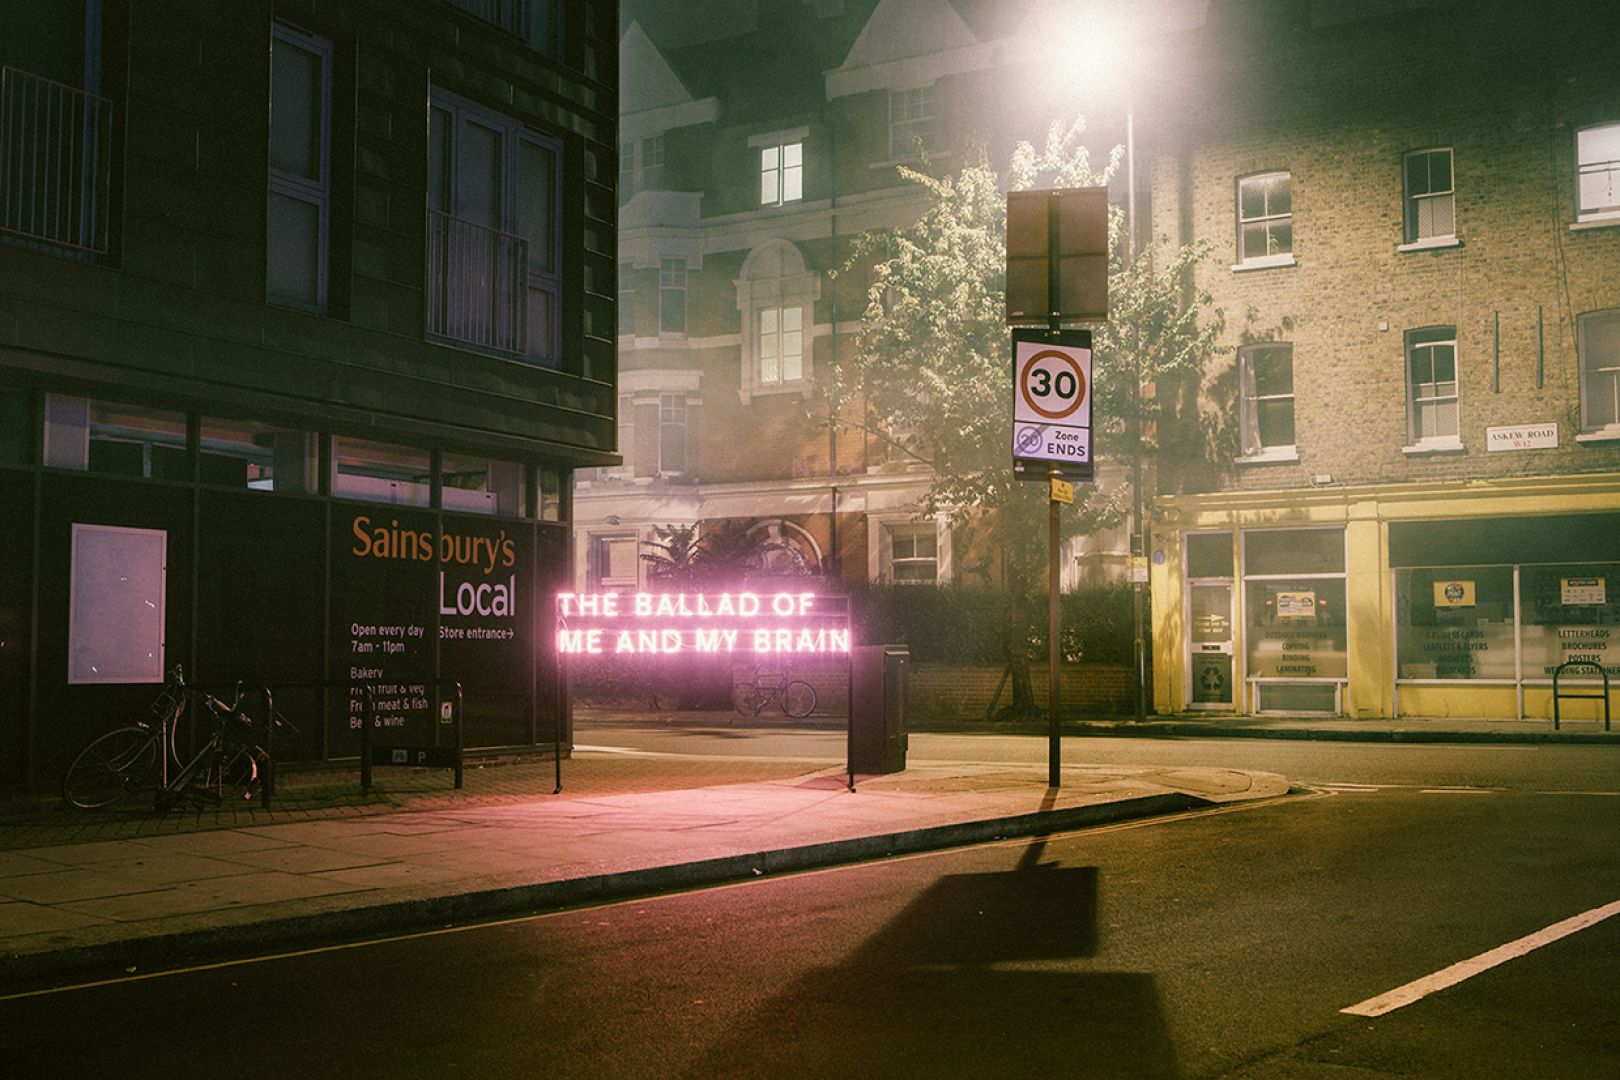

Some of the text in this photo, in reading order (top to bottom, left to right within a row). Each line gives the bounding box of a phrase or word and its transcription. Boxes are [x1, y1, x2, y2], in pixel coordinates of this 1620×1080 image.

[1030, 368, 1077, 399] 30
[1055, 431, 1079, 442] Zone
[1492, 430, 1554, 441] ASKEW ROAD
[1047, 443, 1086, 457] ENDS
[1514, 440, 1532, 448] W12
[352, 516, 515, 574] Sainsbury's
[439, 571, 516, 617] Local
[557, 592, 816, 618] THE BALLAD OF
[350, 622, 425, 639] Open every day
[439, 626, 506, 639] Store entrance
[1558, 629, 1610, 638] LETTERHEADS
[350, 640, 373, 653] 7am
[382, 639, 405, 654] 11pm
[558, 629, 850, 653] ME AND MY BRAIN
[1561, 641, 1607, 650] BROCHURES
[1568, 653, 1601, 662] POSTERS
[350, 666, 384, 679] Bakery
[409, 684, 425, 696] veg
[378, 699, 401, 711] meat
[403, 698, 409, 710] &
[412, 697, 428, 709] fish
[374, 715, 381, 727] &
[384, 715, 405, 726] wine
[418, 750, 427, 763] P
